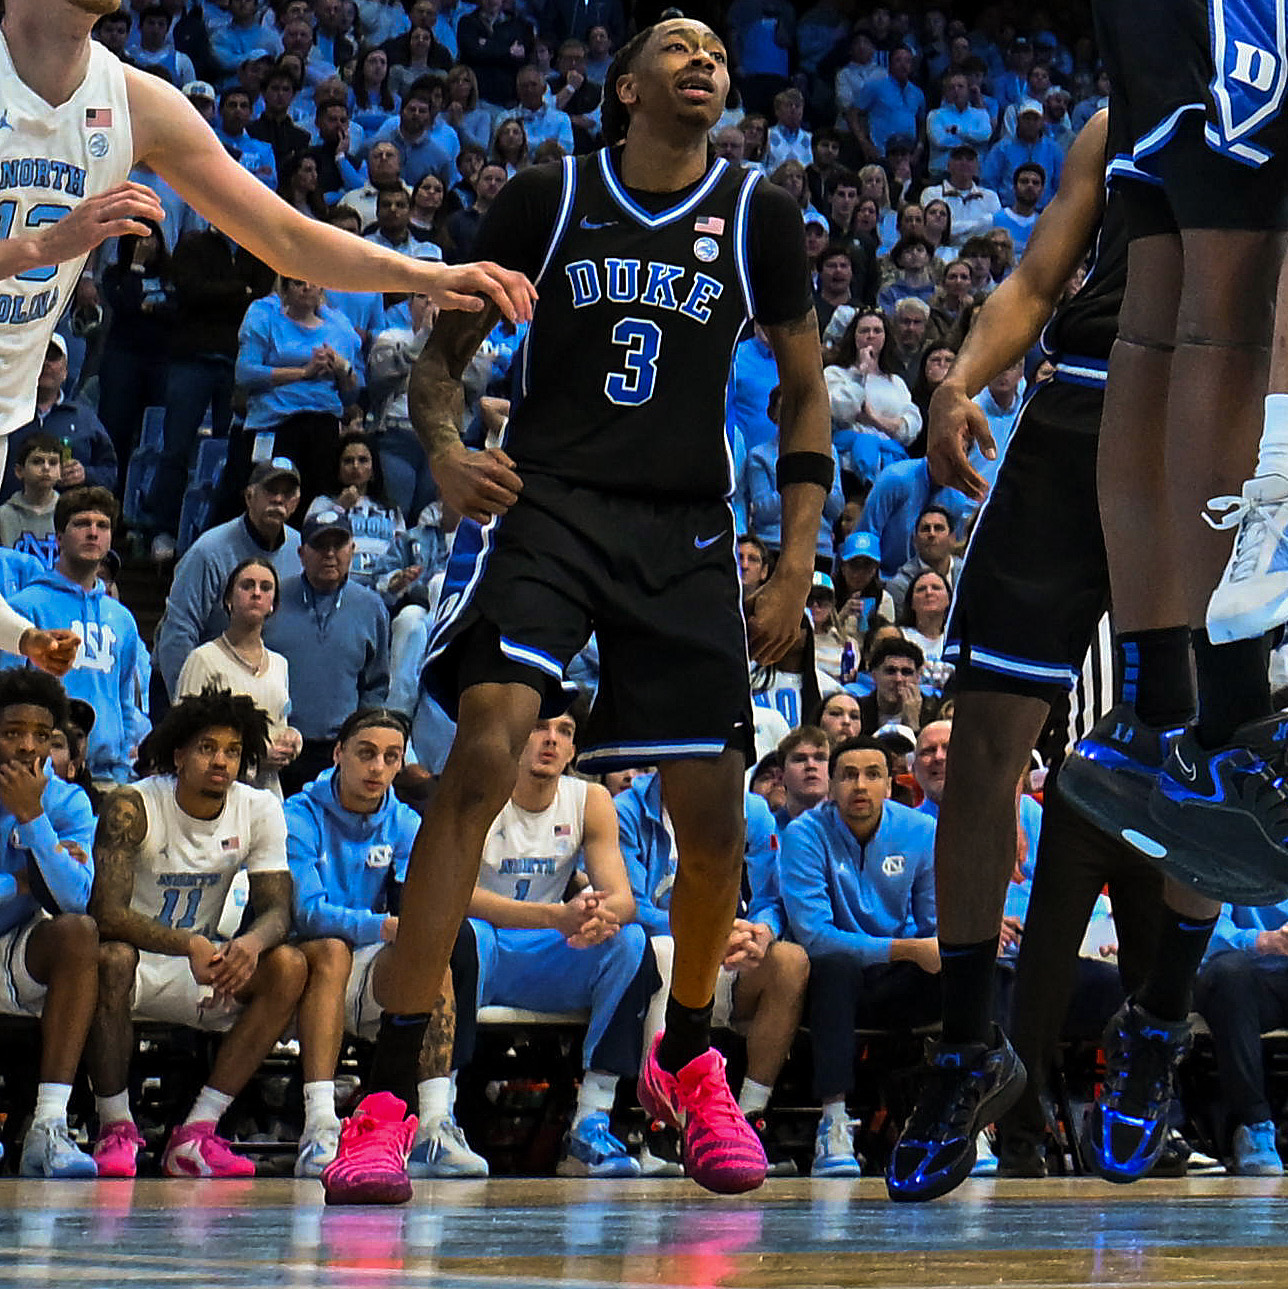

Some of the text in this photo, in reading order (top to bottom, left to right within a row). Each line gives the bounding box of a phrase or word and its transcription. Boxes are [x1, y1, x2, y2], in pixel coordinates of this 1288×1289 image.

[1229, 40, 1278, 92] D
[0, 158, 87, 198] NORTH
[0, 286, 59, 325] OLINA
[565, 257, 724, 325] DUKE
[604, 316, 663, 407] 3
[155, 888, 203, 929] 11
